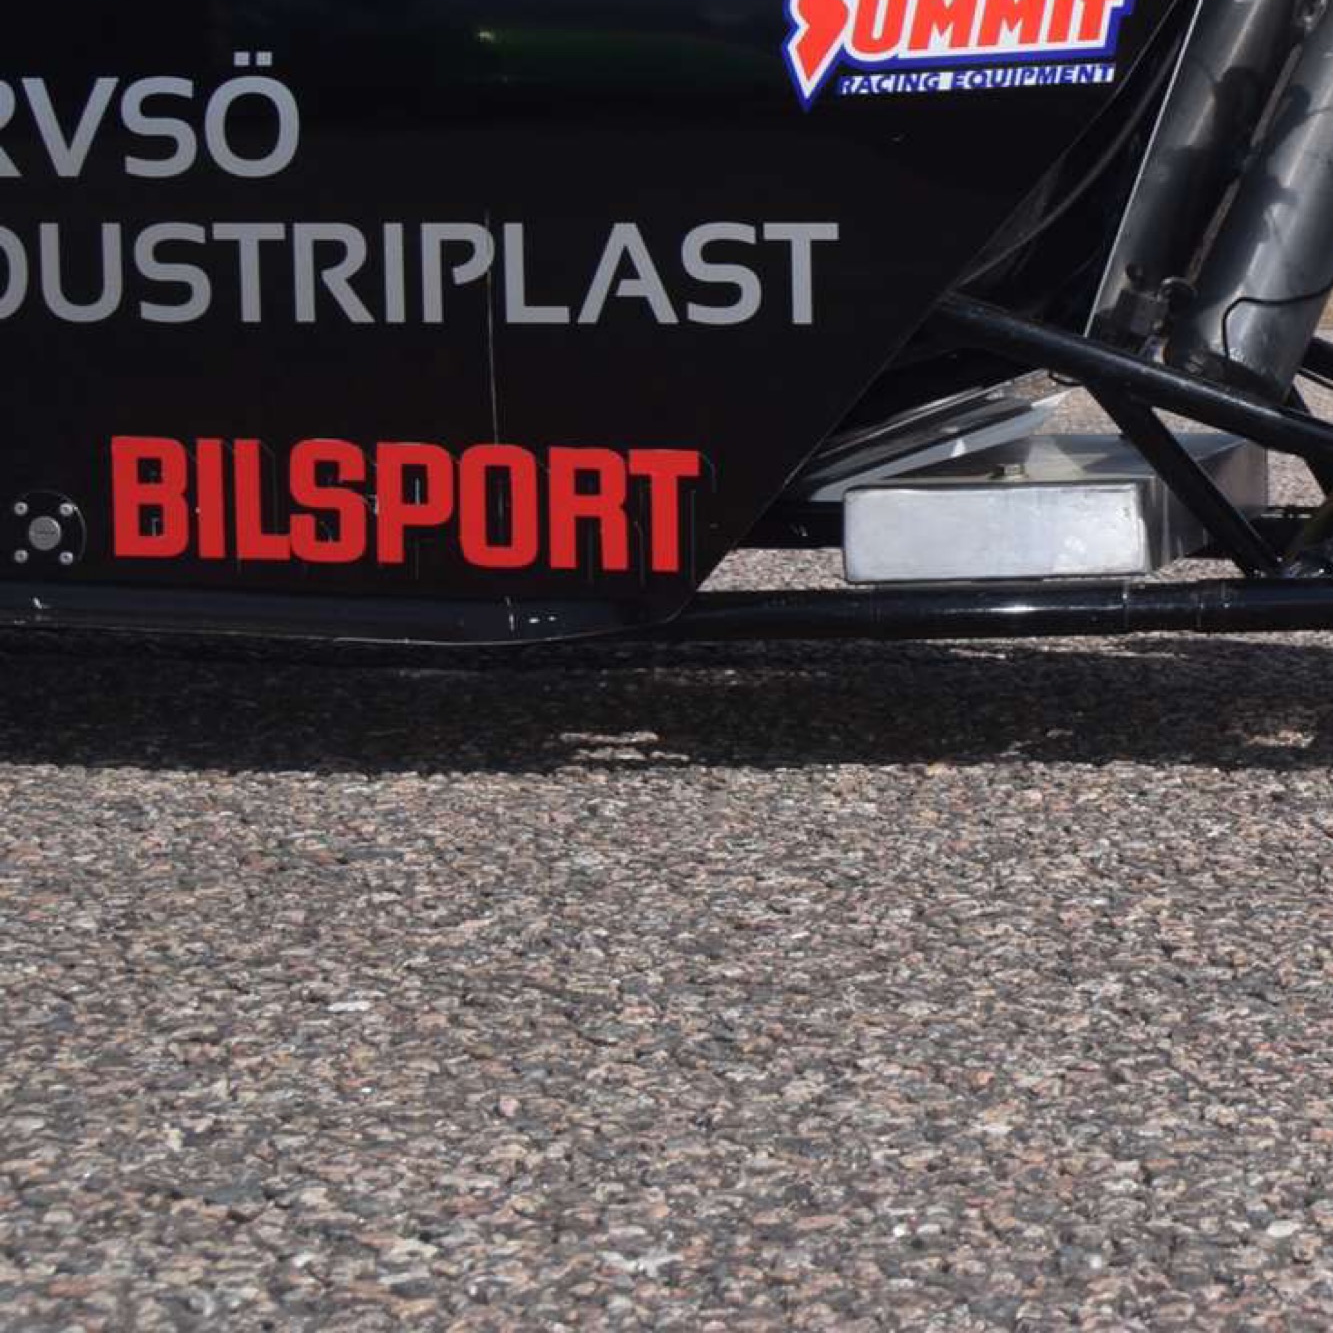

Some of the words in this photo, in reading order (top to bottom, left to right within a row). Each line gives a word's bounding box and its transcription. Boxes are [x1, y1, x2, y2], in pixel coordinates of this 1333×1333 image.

[840, 70, 950, 95] RACING
[952, 63, 1115, 91] EQUIPMENT
[111, 436, 700, 572] BILSPORT
